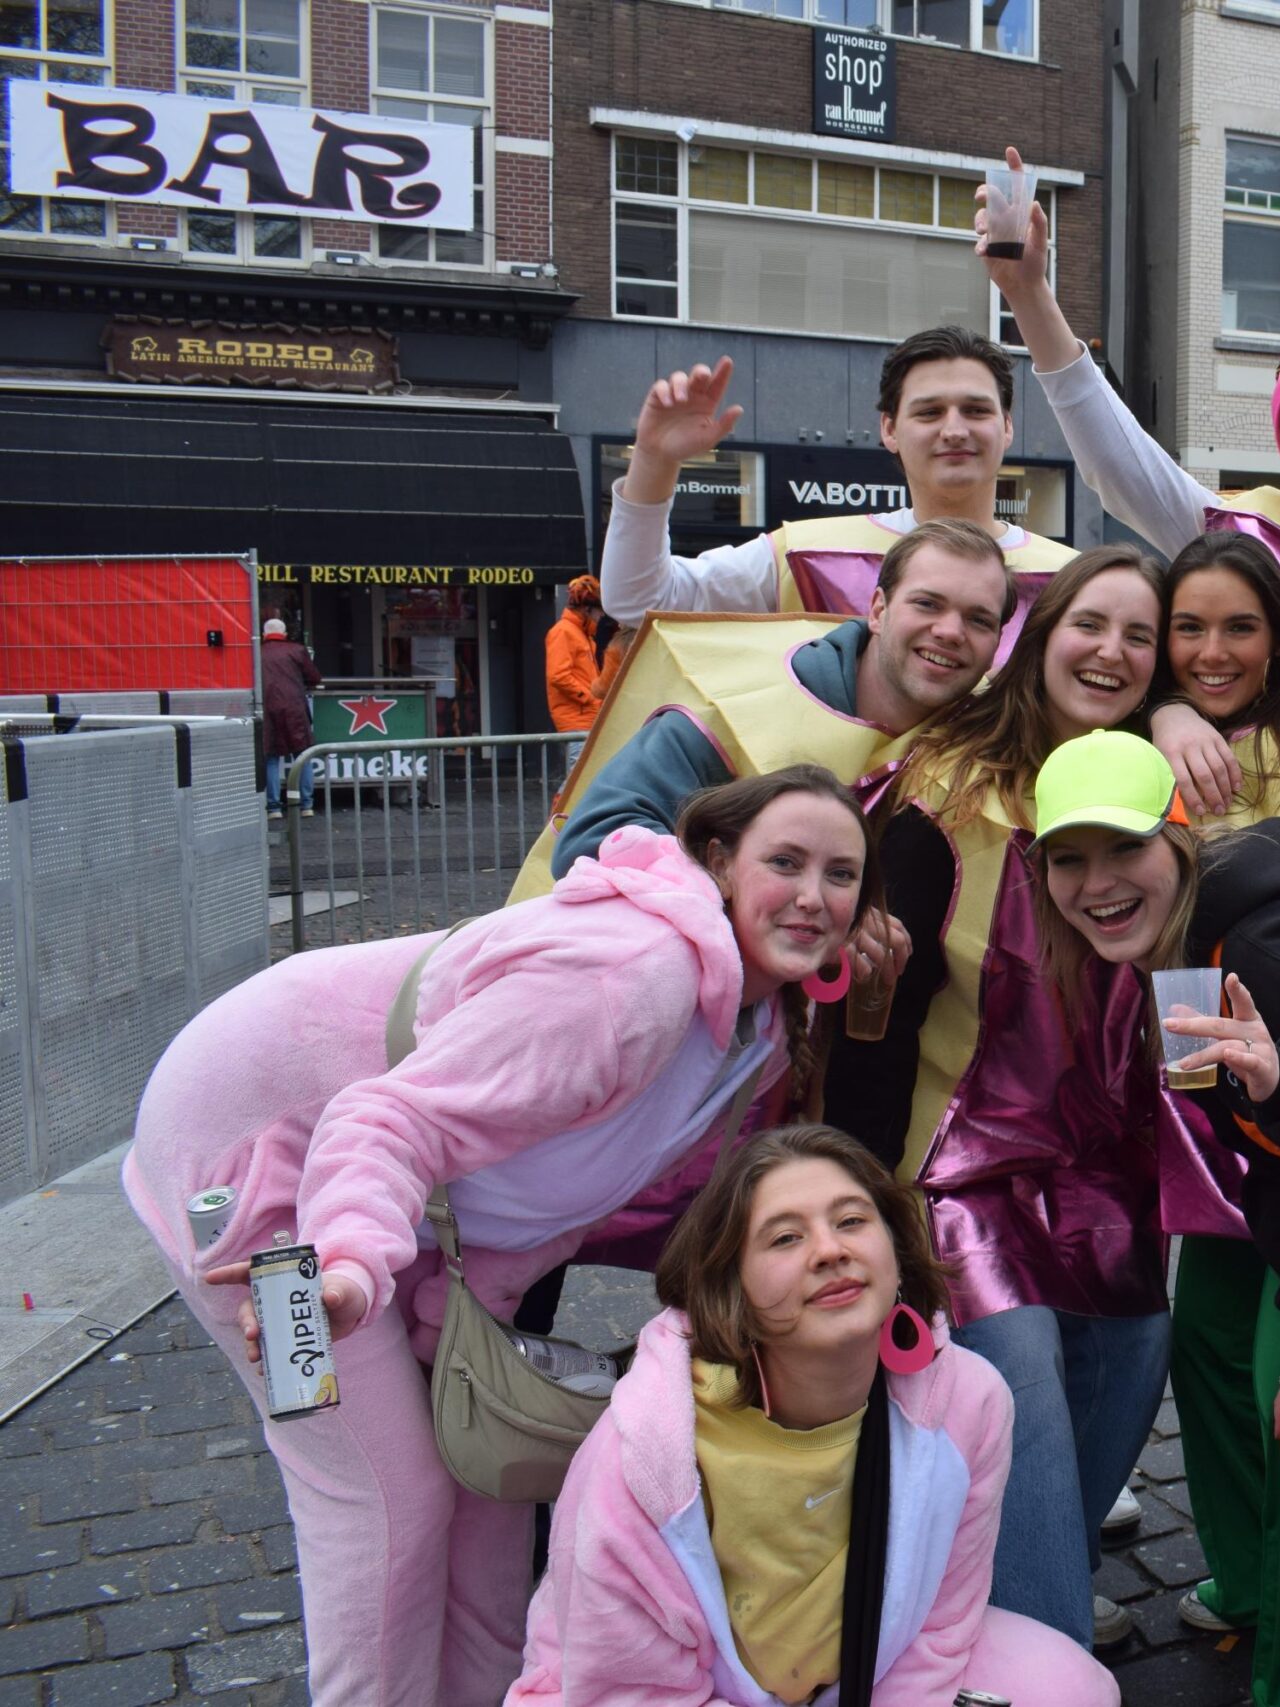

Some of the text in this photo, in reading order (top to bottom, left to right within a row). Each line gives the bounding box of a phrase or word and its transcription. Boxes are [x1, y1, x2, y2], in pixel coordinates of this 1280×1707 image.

[825, 33, 887, 51] AUTHORIZED
[46, 91, 442, 219] BAR
[177, 338, 333, 362] RODEO
[130, 351, 376, 373] LATIN AMERICAN GRILL RESTAURANT
[688, 481, 751, 495] Bommel
[788, 480, 907, 508] VABOTTI
[310, 565, 453, 584] RESTAURANT
[468, 567, 534, 584] RODEO
[289, 1288, 325, 1378] VIPER
